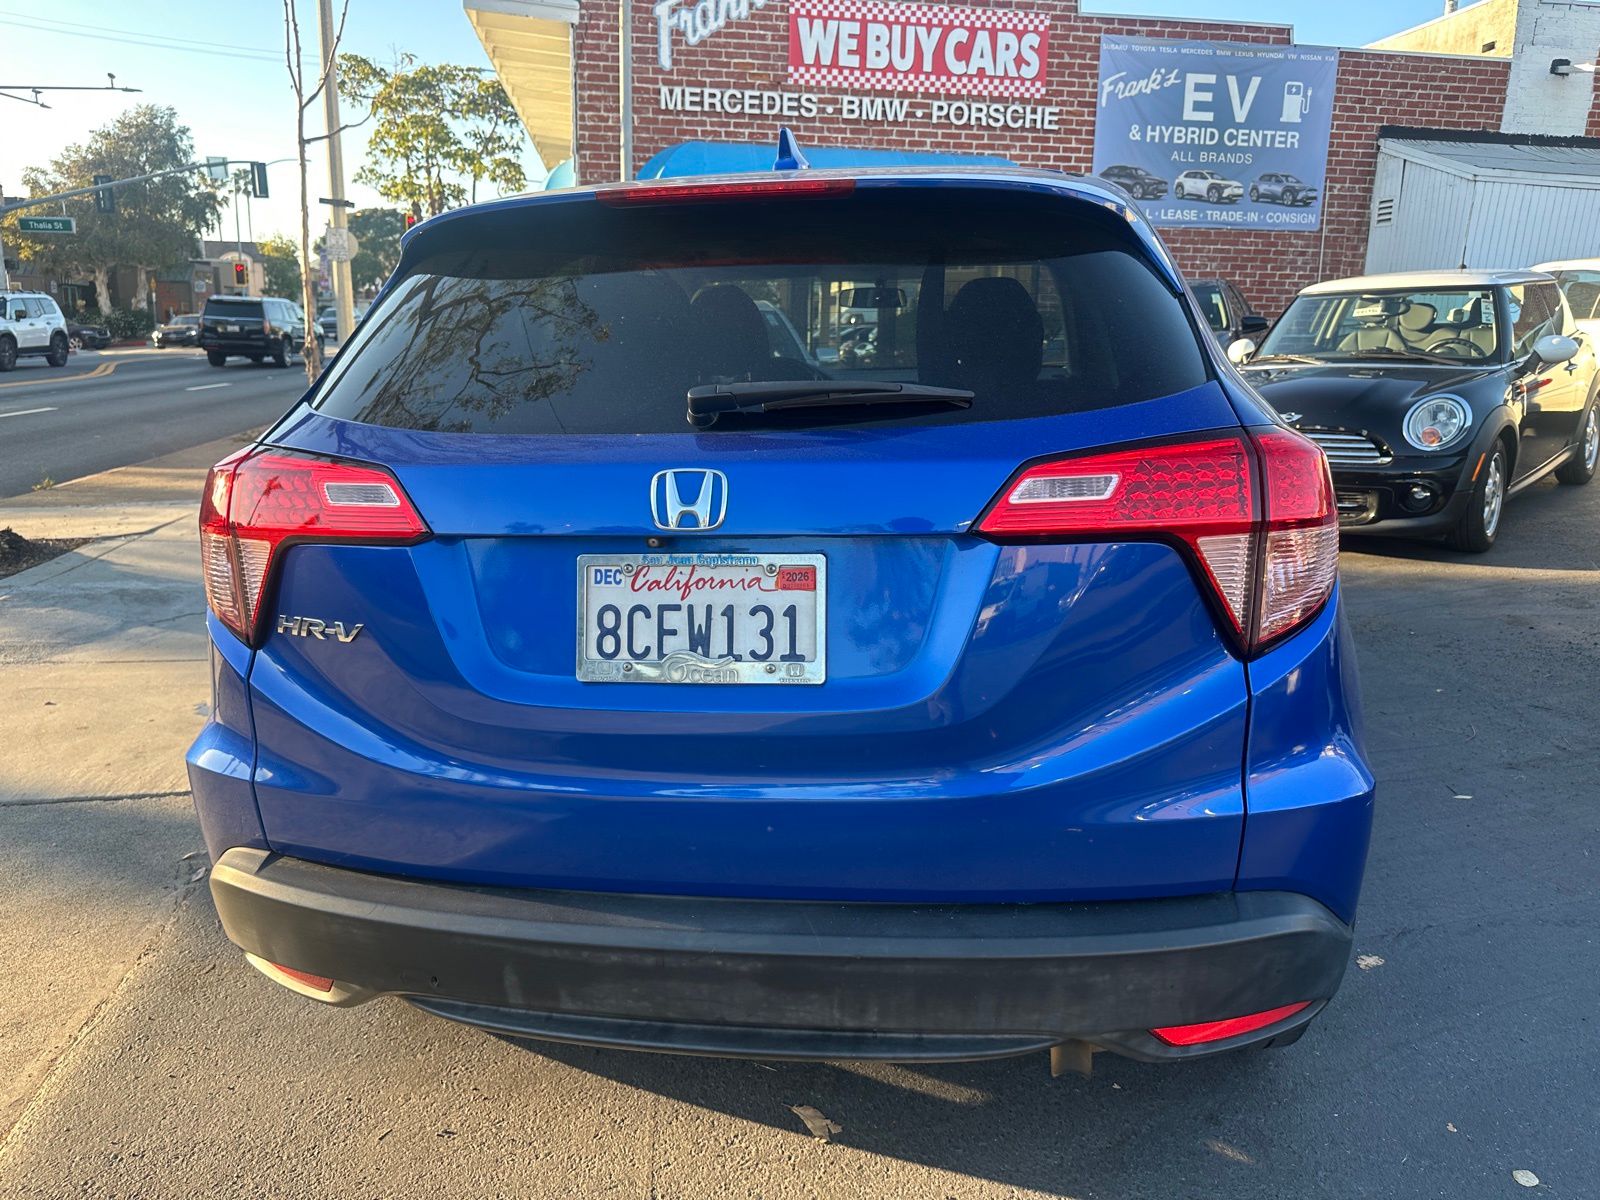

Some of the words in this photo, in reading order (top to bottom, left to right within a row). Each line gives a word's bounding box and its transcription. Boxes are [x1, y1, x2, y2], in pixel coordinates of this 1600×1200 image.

[797, 18, 861, 68] WE
[866, 22, 943, 72] BUY
[944, 28, 1041, 79] CARS
[1102, 43, 1128, 51] SUBARU
[1131, 44, 1156, 53] TOYOTA
[1159, 46, 1178, 54] TESLA
[1181, 47, 1213, 56] MERCEDES
[1216, 49, 1231, 57] BMW
[1235, 50, 1254, 58] LEXUS
[1257, 51, 1284, 60] HYUNDAI
[1300, 53, 1322, 61] NISSAN
[1101, 68, 1182, 107] Frank's
[1182, 72, 1262, 123] EV
[660, 86, 818, 118] MERCEDES
[842, 96, 909, 122] BMW
[931, 101, 1060, 130] PORSCHE
[1129, 124, 1142, 140] &
[1146, 125, 1219, 145] HYBRID
[1223, 128, 1300, 149] CENTER
[1170, 151, 1195, 162] ALL
[1199, 152, 1253, 165] BRANDS
[29, 220, 52, 229] Thalia
[53, 220, 64, 229] St
[1160, 208, 1198, 220] LEASE
[1206, 210, 1259, 222] TRADE-IN
[1266, 212, 1316, 224] CONSIGN
[641, 554, 663, 565] San
[667, 554, 693, 565] Juan
[696, 553, 759, 568] Capistrano
[594, 569, 623, 585] DEC
[630, 565, 779, 601] California
[786, 572, 810, 582] 2026
[277, 614, 364, 643] HR-V
[596, 603, 806, 662] 8CEW131
